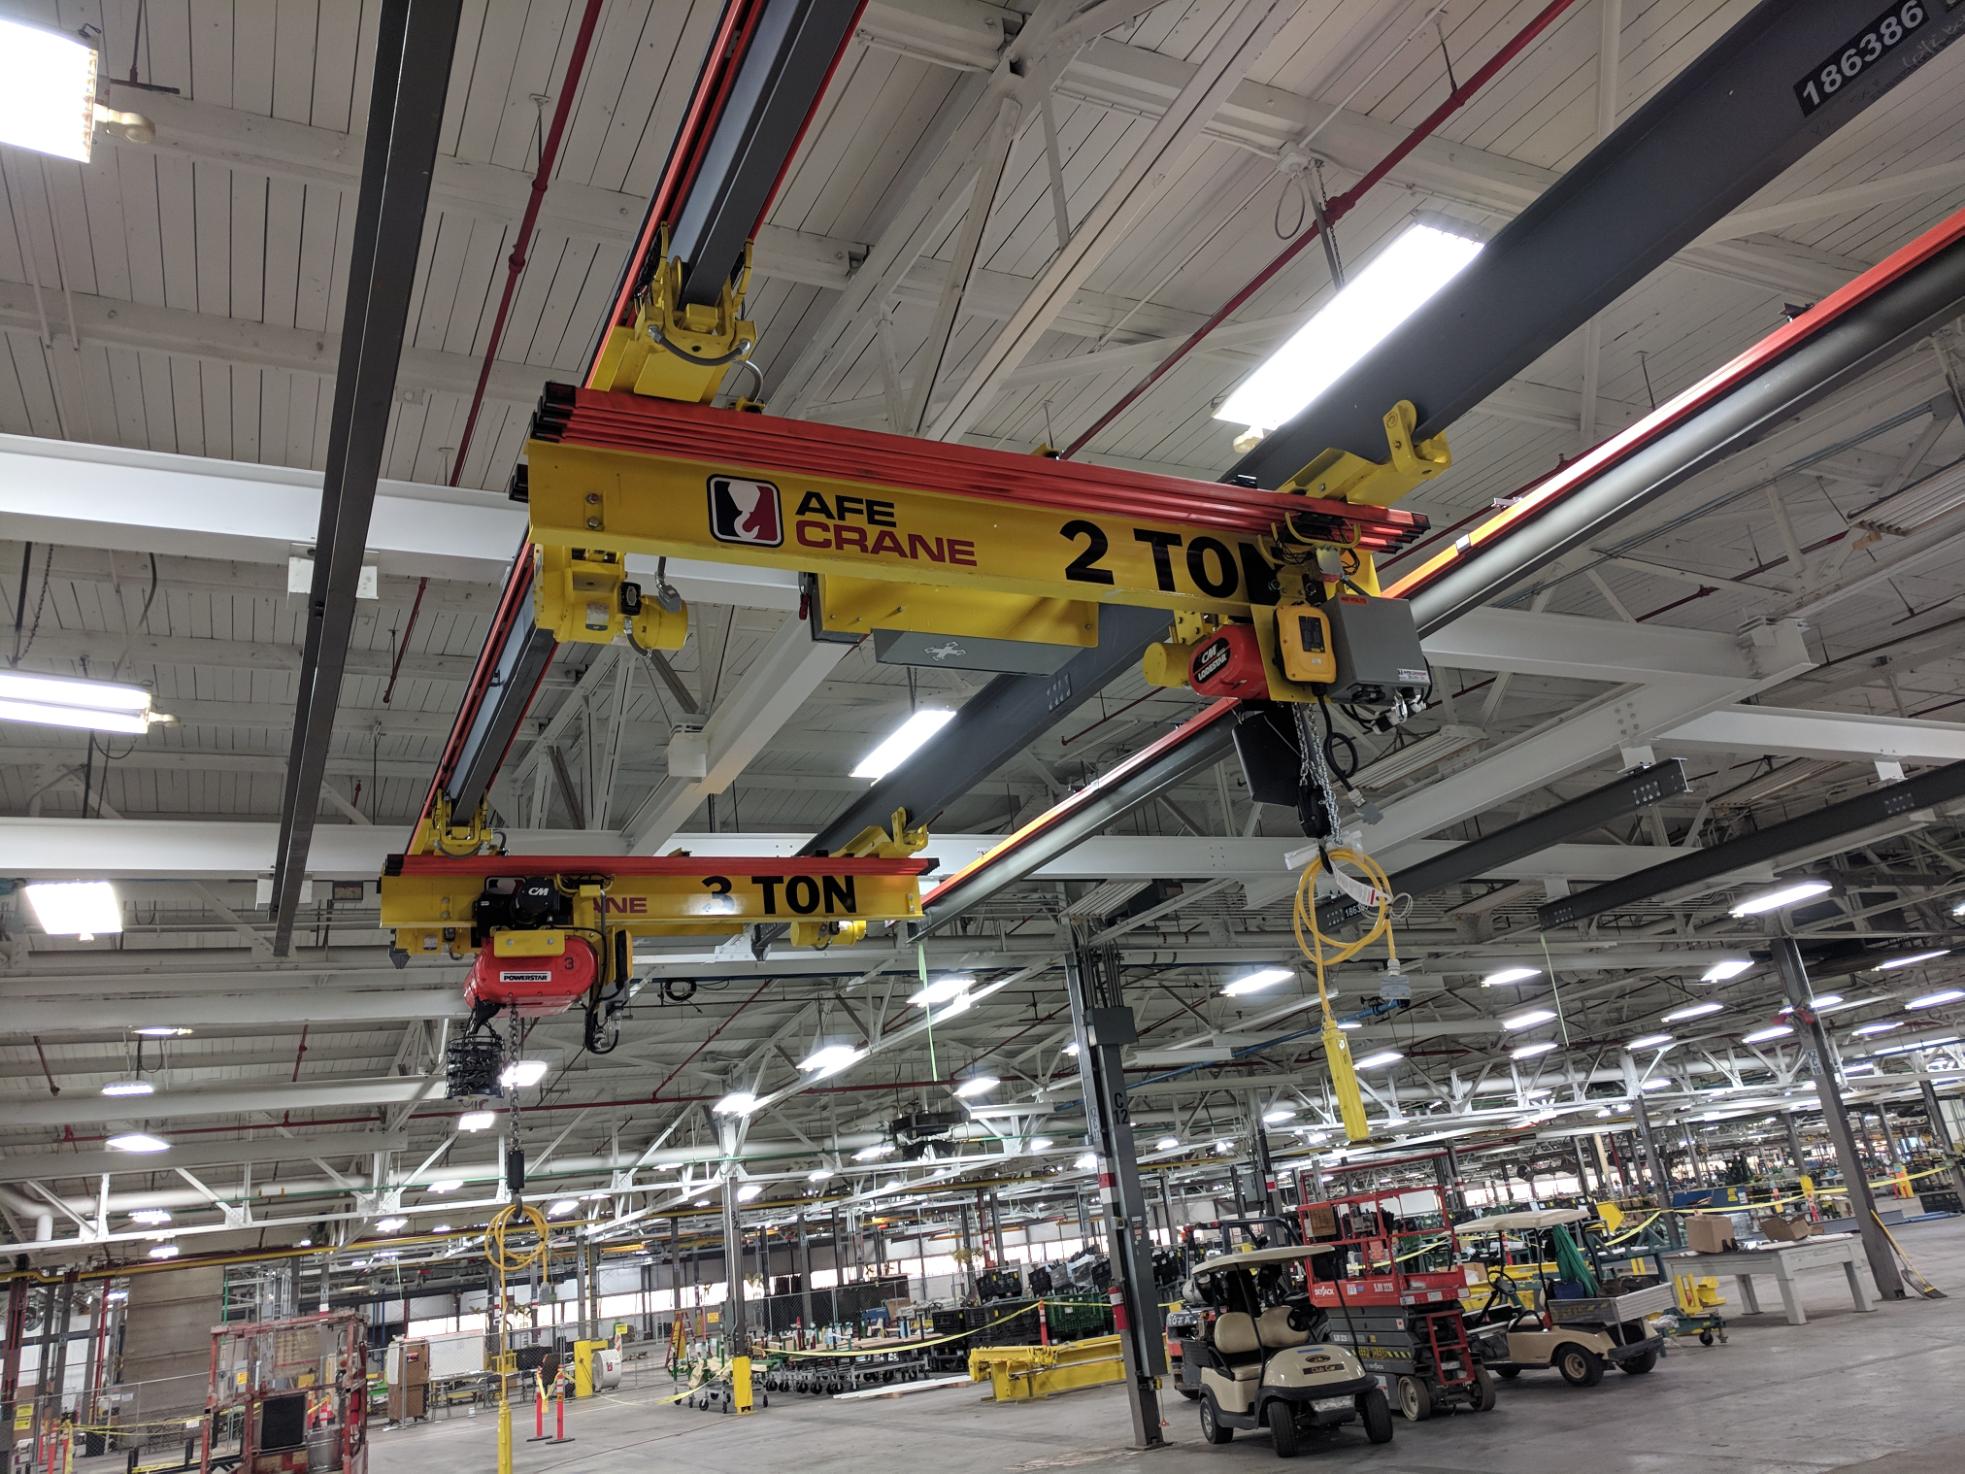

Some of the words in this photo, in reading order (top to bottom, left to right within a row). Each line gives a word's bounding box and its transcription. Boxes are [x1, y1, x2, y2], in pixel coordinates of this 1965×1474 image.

[1803, 0, 1923, 105] 186386
[795, 490, 896, 528] AFE
[796, 520, 977, 567] CRANE
[1059, 519, 1115, 585] 2
[1198, 652, 1227, 681] LODESTAR
[1201, 643, 1217, 664] CM
[528, 887, 549, 896] CM
[702, 876, 735, 915] 3
[751, 875, 857, 915] TON
[564, 957, 575, 970] 3
[1114, 1092, 1124, 1109] C
[1113, 1108, 1131, 1125] 12
